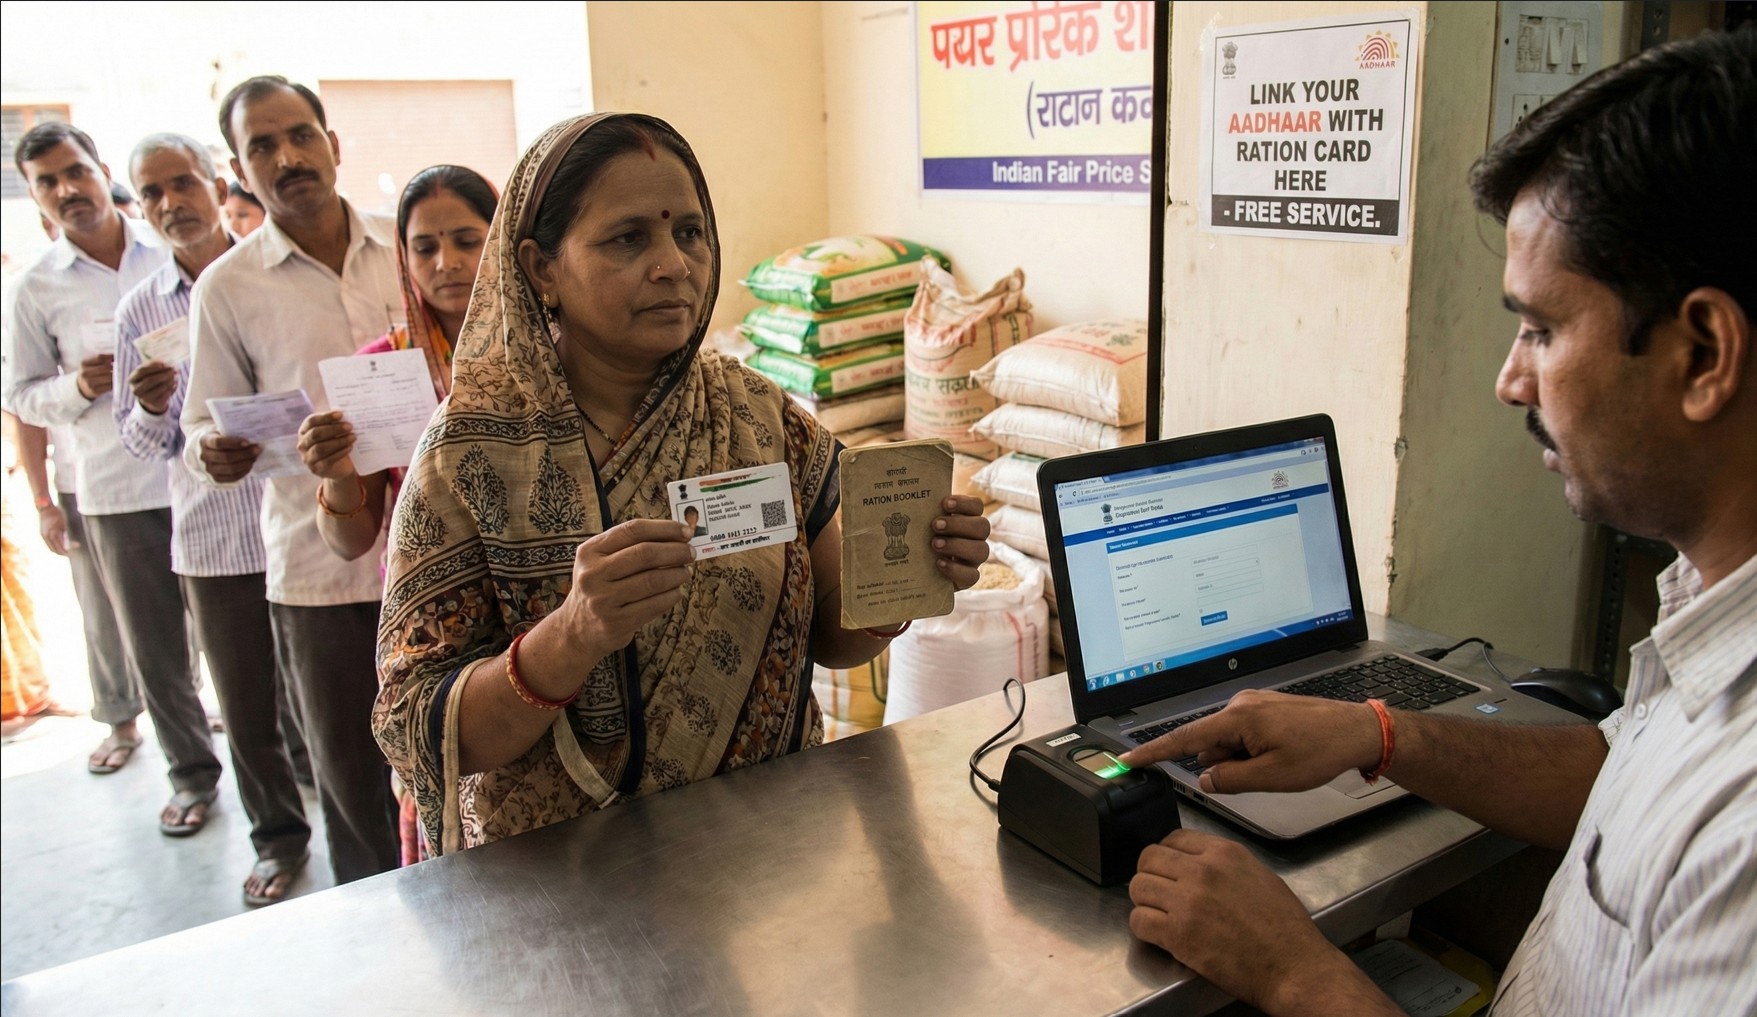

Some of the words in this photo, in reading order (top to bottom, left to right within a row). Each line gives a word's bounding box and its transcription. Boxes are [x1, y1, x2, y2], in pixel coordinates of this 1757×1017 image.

[1359, 60, 1396, 70] AADHAAR
[1250, 81, 1296, 105] LINK
[1302, 78, 1360, 103] YOUR
[1228, 110, 1322, 134] AADHAAR
[1328, 108, 1384, 132] WITH
[1236, 140, 1307, 163] RATION
[1314, 139, 1372, 163] CARD
[992, 160, 1043, 184] Indian
[1047, 161, 1082, 184] Fair
[1085, 160, 1134, 184] Price
[1274, 169, 1327, 192] HERE
[1234, 200, 1282, 223] FREE
[1286, 201, 1381, 228] SERVICE.
[862, 495, 892, 507] RATION
[893, 489, 932, 502] BOOKLET
